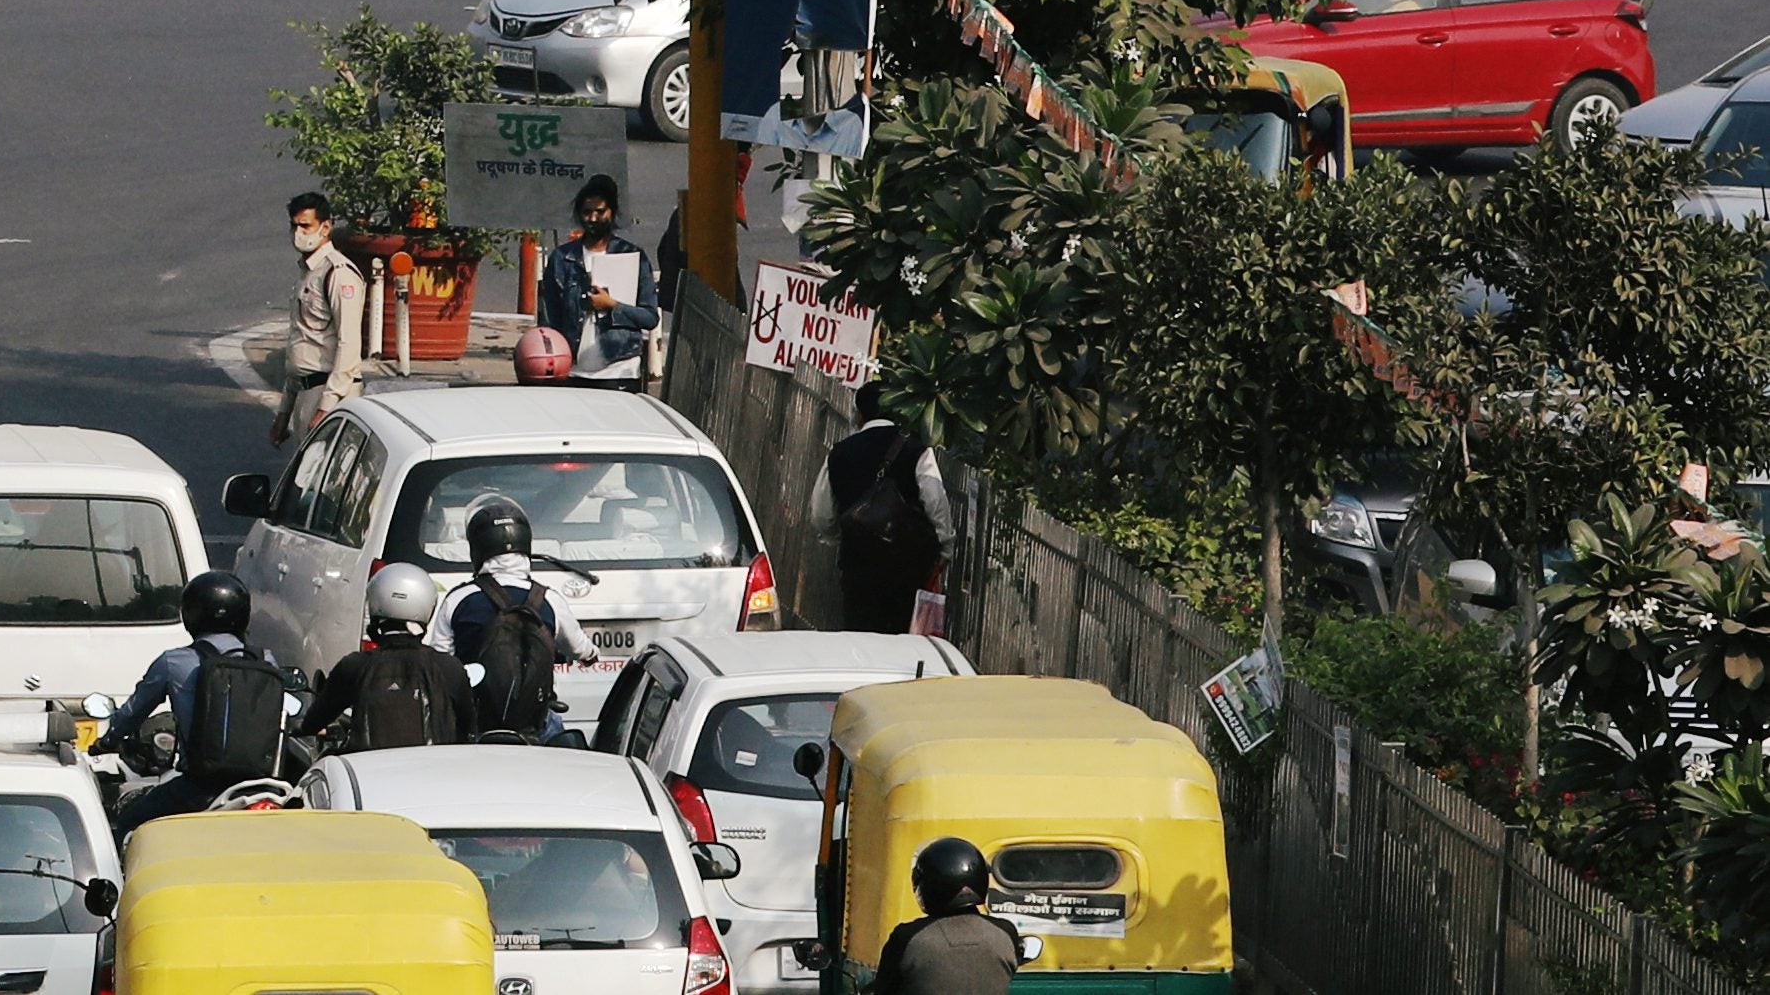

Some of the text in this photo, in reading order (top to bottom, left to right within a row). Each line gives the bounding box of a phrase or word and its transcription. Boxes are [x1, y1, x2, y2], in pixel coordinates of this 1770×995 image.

[496, 113, 562, 157] युद्ध
[476, 158, 585, 179] प्रदूषण के विरुद्ध
[786, 275, 821, 308] YOU
[801, 312, 841, 345] NOT
[592, 631, 635, 648] 0008
[494, 934, 541, 944] AUTOWEB
